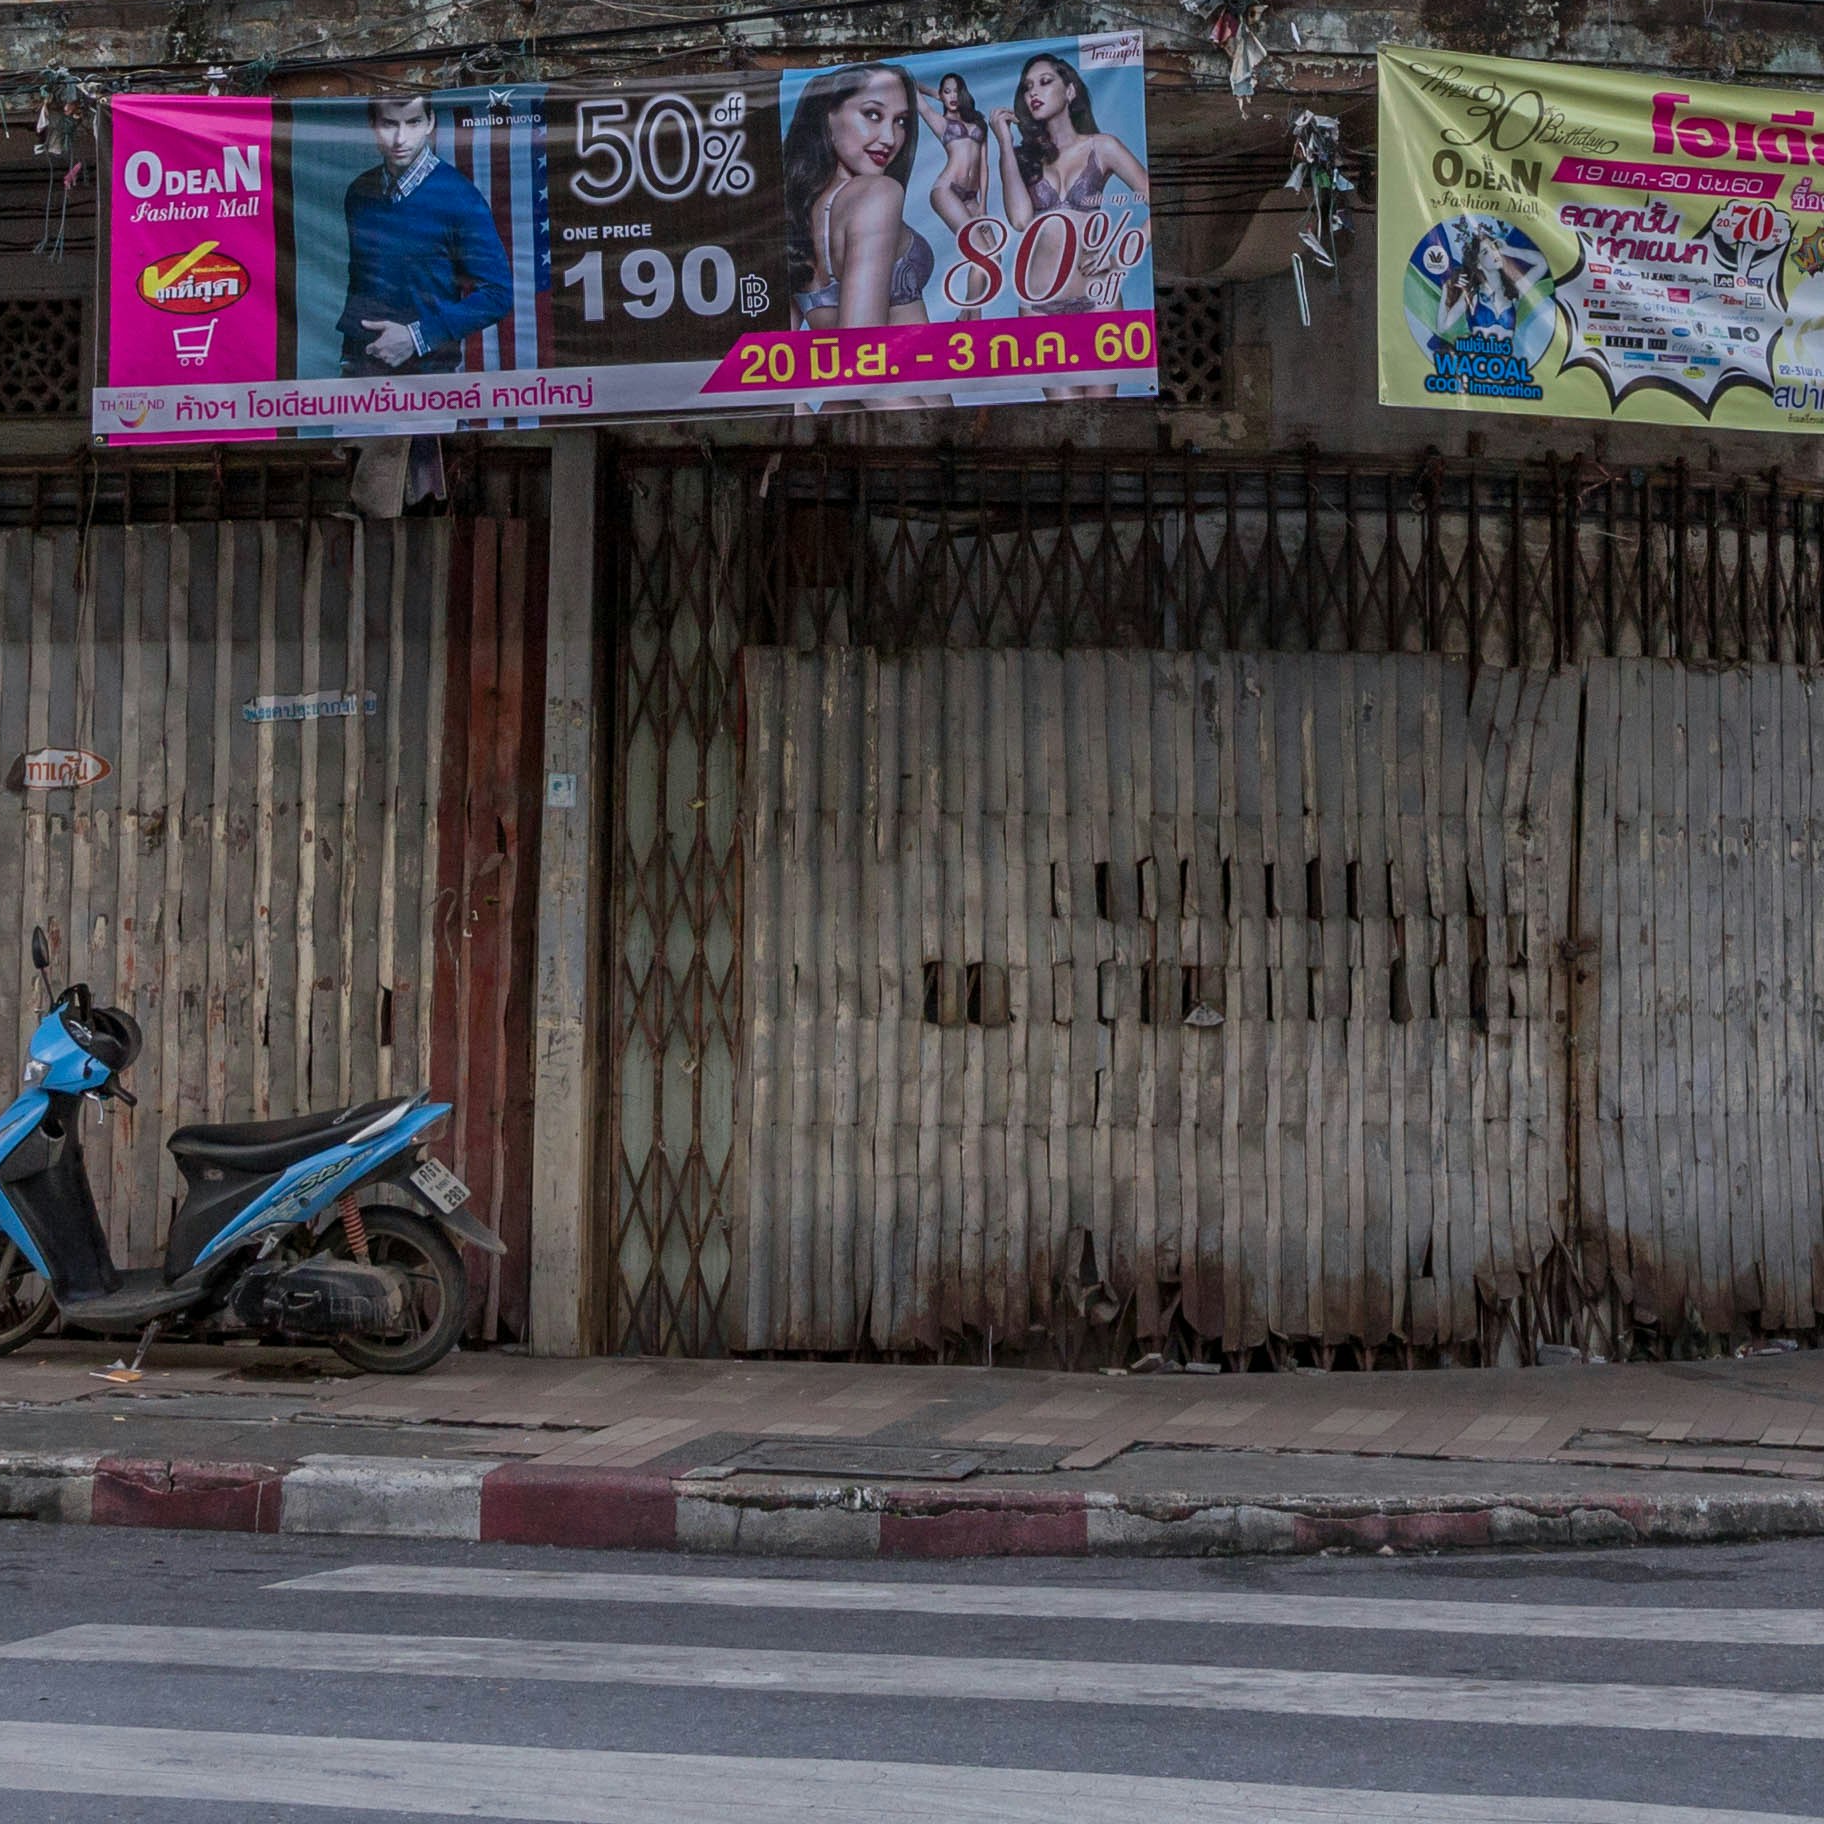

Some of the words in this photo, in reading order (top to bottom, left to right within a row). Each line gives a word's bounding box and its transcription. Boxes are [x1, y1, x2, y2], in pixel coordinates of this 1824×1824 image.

[1082, 38, 1142, 64] Triumph
[462, 113, 504, 128] manlio
[505, 113, 542, 125] nuovo
[713, 96, 743, 122] off
[572, 94, 753, 202] 50%
[1533, 112, 1619, 155] Birthday
[1575, 164, 1602, 181] 19
[130, 201, 210, 223] Fashion
[216, 197, 260, 218] Mall
[1437, 189, 1500, 212] Fashion
[1505, 198, 1540, 218] Mall
[1559, 202, 1681, 234] ลดทุกชั้น
[562, 225, 599, 241] ONE
[602, 223, 653, 239] PRICE
[944, 210, 1146, 307] 80%
[1596, 236, 1709, 266] ทุกแผนก
[1088, 271, 1126, 306] off
[740, 343, 795, 384] 20
[809, 337, 900, 380] มิ.ย.
[915, 353, 934, 363] -
[948, 332, 975, 371] 3
[989, 331, 1080, 369] ก.ค.
[1094, 321, 1152, 363] 60
[1455, 331, 1513, 355] แฟชั่นโชว์
[1435, 353, 1533, 382] WACOAL
[176, 392, 236, 421] ห้างฯ
[247, 378, 482, 419] โอเดียนแฟชั่นมอลล์
[492, 377, 594, 409] หาดใหญ่
[1468, 378, 1542, 399] Innovation
[100, 397, 165, 413] THAILAND
